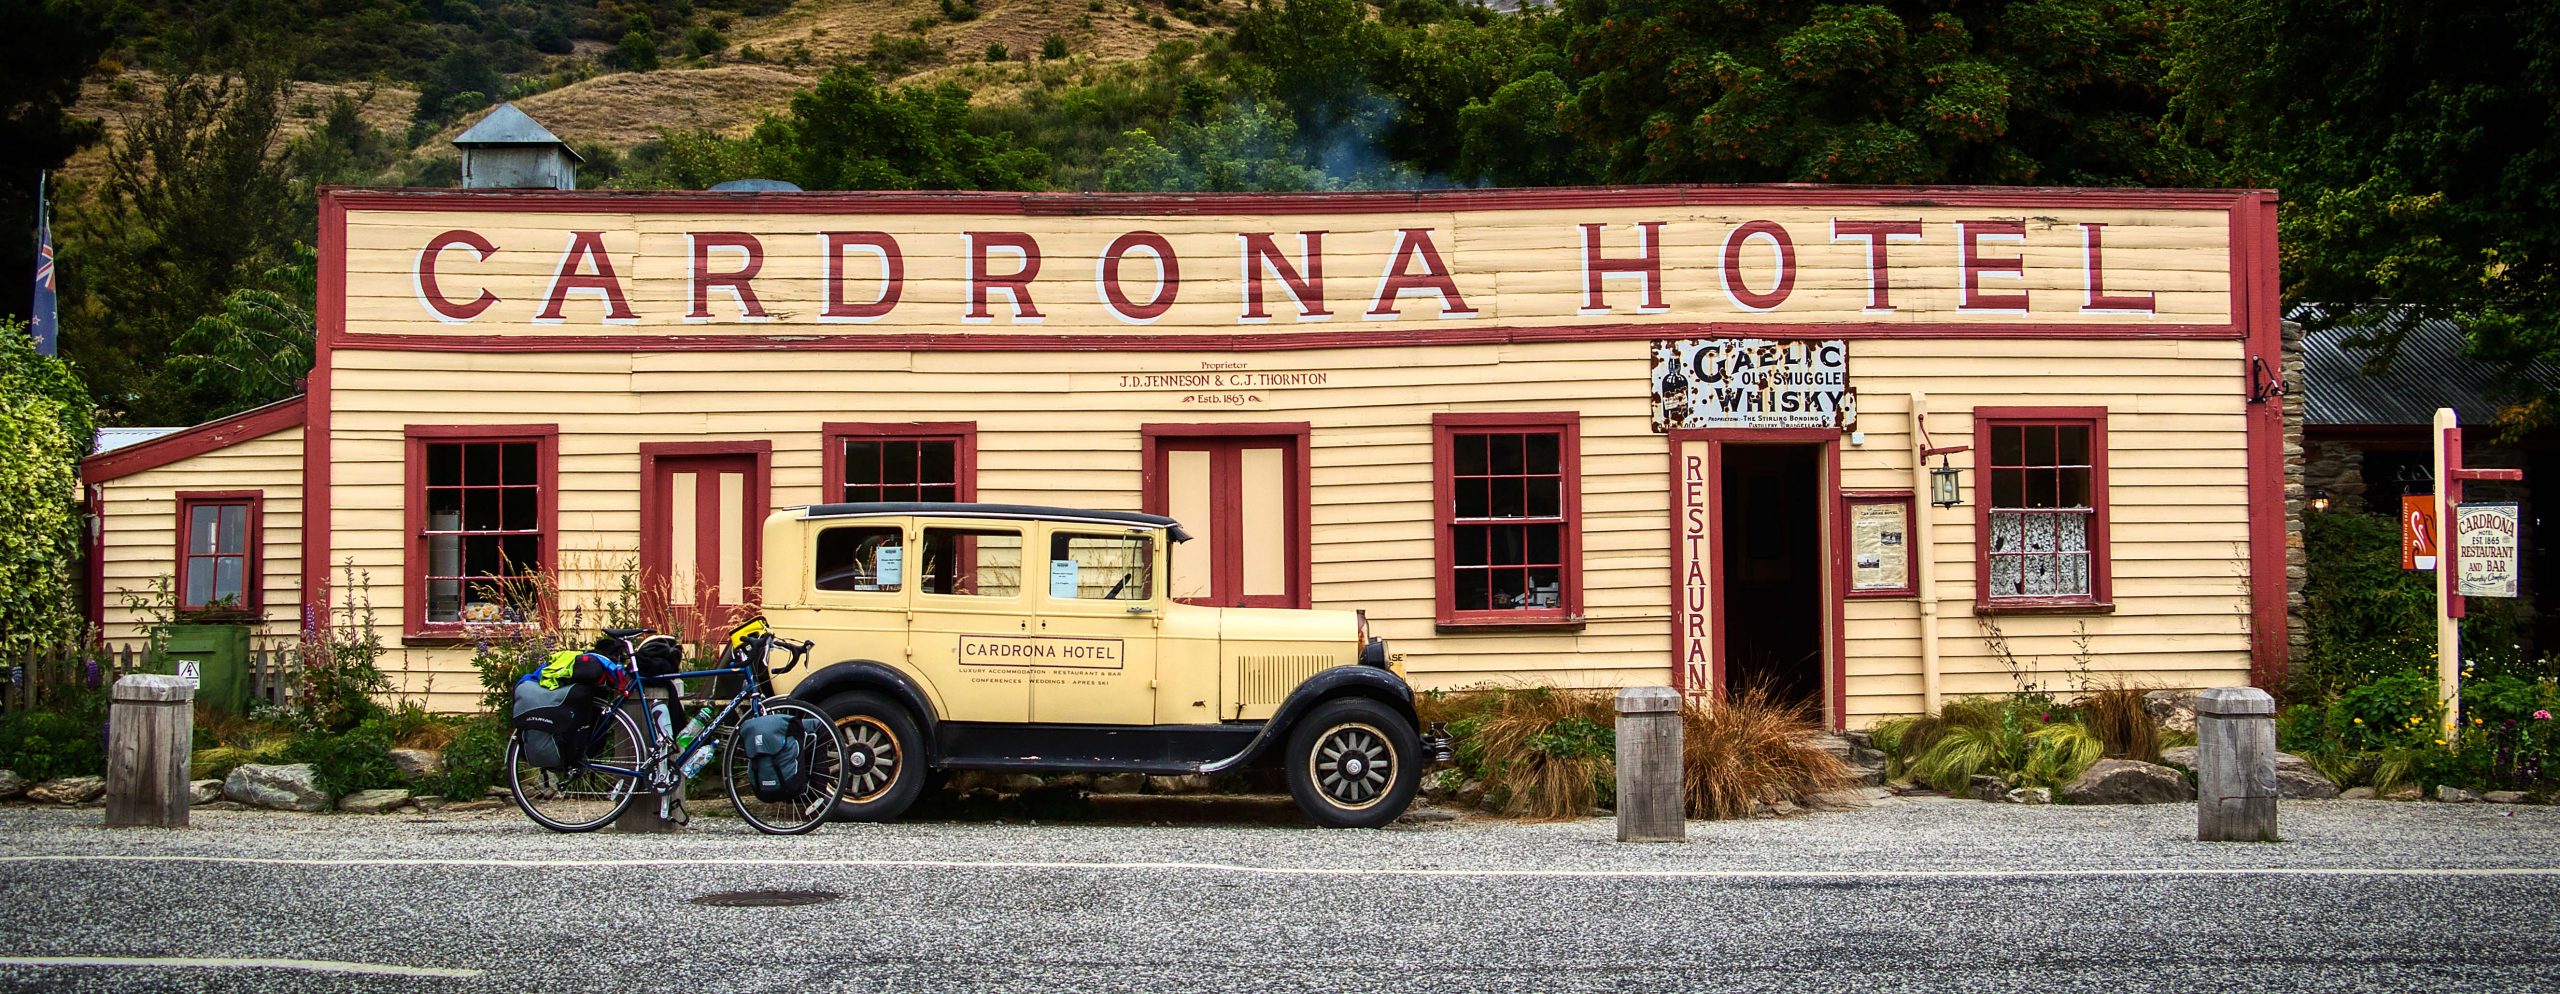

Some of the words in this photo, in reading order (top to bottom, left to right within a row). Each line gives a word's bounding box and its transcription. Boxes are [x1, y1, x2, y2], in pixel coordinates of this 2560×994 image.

[412, 227, 1479, 325] CARDRONA
[1577, 217, 2156, 318] HOTEL
[1201, 361, 1248, 371] Proprietor
[1693, 345, 1842, 384] GAELIC
[1214, 375, 1224, 386] &
[1774, 371, 1846, 386] SMUGGLE
[1197, 394, 1221, 404] Estb.
[1715, 388, 1845, 413] WHISKY
[2459, 513, 2514, 537] CARDRONA
[2460, 545, 2514, 559] RESTAURANT
[2468, 562, 2483, 572] AND
[2487, 560, 2506, 573] BAR
[1686, 456, 1706, 713] RESTAURANT
[966, 643, 1056, 657] CARDRONA
[1063, 646, 1115, 659] HOTEL
